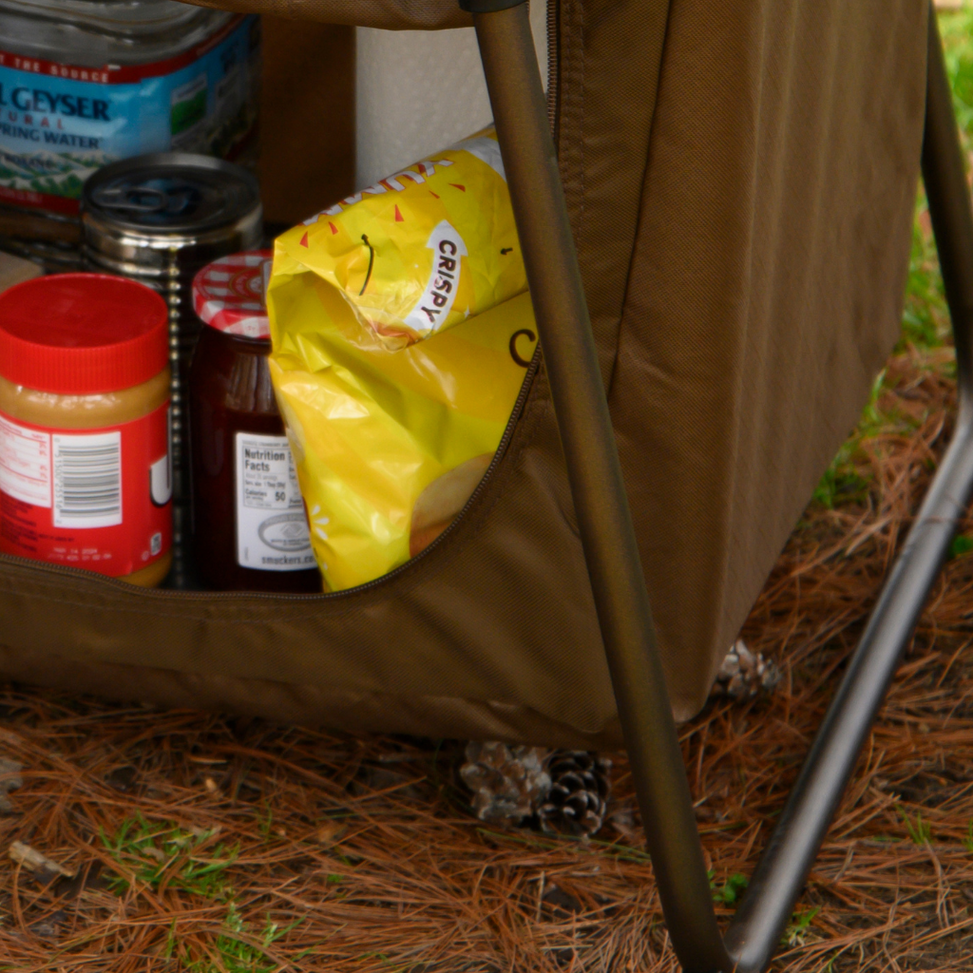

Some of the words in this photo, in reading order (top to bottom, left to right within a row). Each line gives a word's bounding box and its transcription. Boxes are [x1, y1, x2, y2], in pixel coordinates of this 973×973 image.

[14, 58, 40, 73] THE
[50, 65, 109, 84] SOURCE
[11, 87, 112, 122] GEYSER
[43, 130, 100, 150] WATER
[420, 239, 458, 323] CRISPY
[244, 448, 286, 461] Nutrition
[244, 460, 270, 472] Facts
[275, 491, 286, 502] 50
